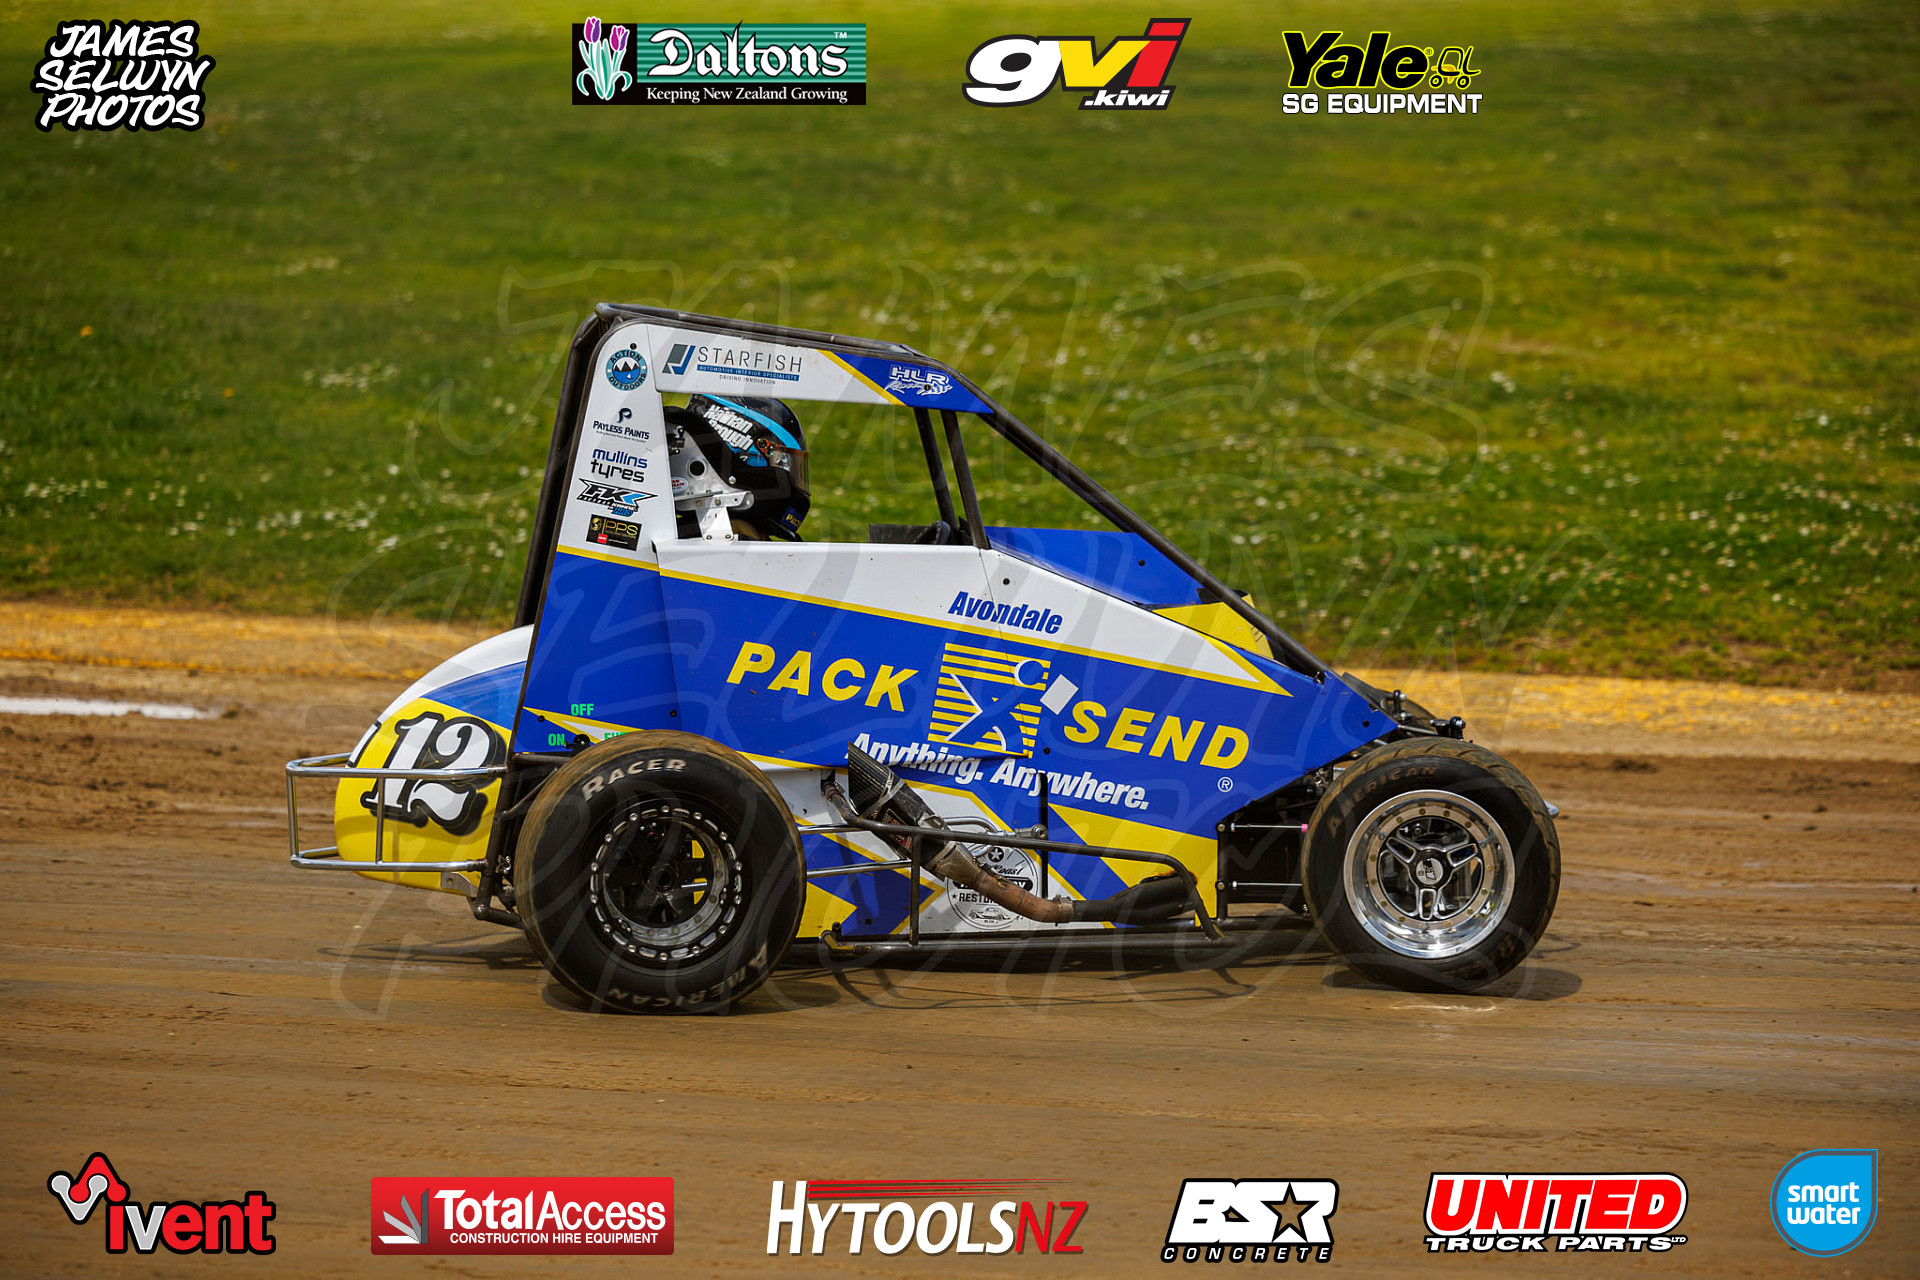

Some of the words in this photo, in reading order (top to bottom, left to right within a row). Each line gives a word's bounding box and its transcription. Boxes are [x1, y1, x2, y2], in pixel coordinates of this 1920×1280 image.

[611, 350, 642, 363] ACTION
[697, 346, 802, 372] STARFISH
[609, 373, 647, 390] OUTDOORS
[743, 376, 776, 385] INNOVATION
[889, 365, 949, 385] HLR
[592, 420, 623, 434] PAYLESS
[624, 427, 650, 440] PAINTS
[592, 448, 648, 469] mullins
[590, 459, 645, 483] tyres
[605, 520, 639, 536] PPS
[947, 590, 1063, 635] Avondale
[570, 703, 595, 716] OFF
[726, 641, 919, 712] PACK
[1064, 700, 1250, 769] SEND
[548, 733, 565, 746] ON
[582, 758, 688, 802] RACER
[846, 732, 983, 785] Anything.
[989, 756, 1149, 810] Anywhere.
